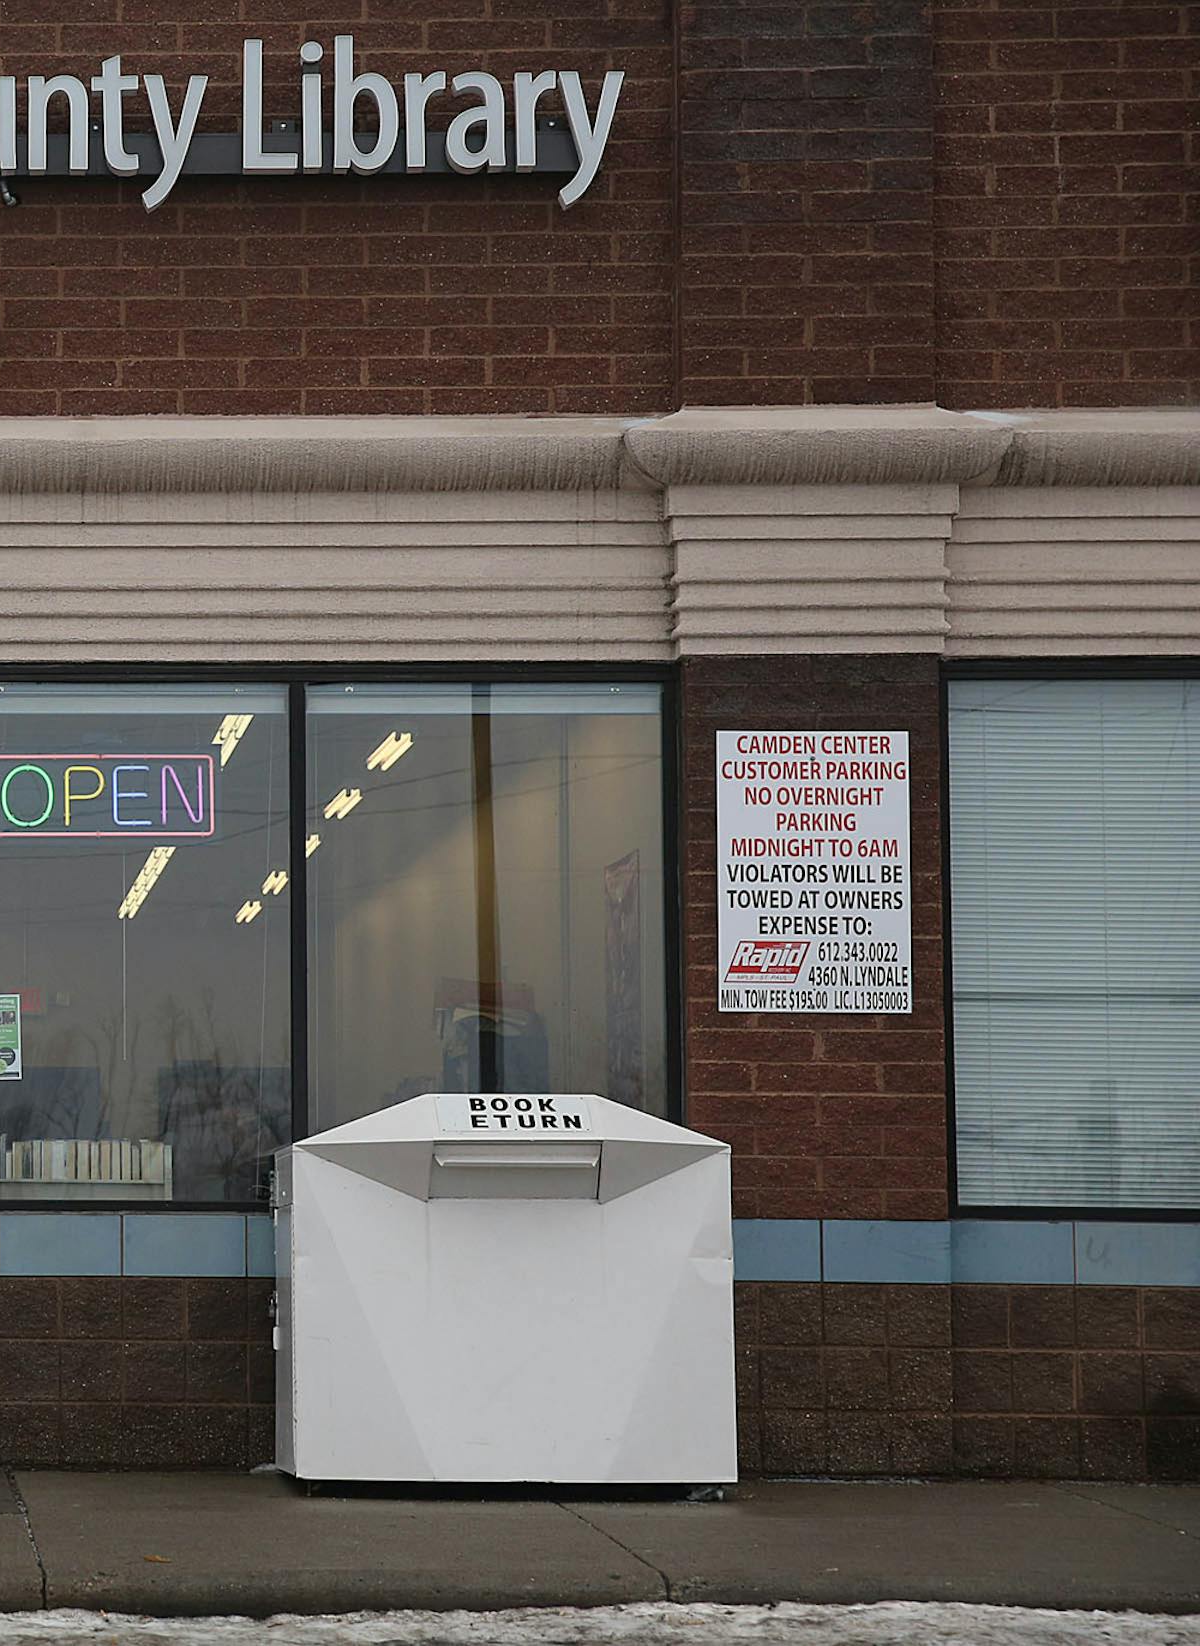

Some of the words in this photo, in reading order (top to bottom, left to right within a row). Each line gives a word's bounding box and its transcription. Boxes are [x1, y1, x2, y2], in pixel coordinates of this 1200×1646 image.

[242, 35, 625, 211] Library
[736, 735, 816, 754] CAMDEN
[821, 736, 891, 755] CENTER
[722, 761, 821, 780] CUSTOMER
[826, 761, 906, 781] PARKING
[0, 764, 204, 827] OPEN
[744, 787, 772, 805] NO
[777, 787, 884, 806] OVERNIGHT
[776, 813, 856, 832] PARKING
[731, 838, 825, 857] MIDNIGHT
[829, 839, 853, 857] TO
[857, 839, 898, 857] 6AM
[727, 864, 828, 883] VIOLATORS
[832, 865, 876, 884] WILL
[881, 865, 903, 884] BE
[727, 890, 793, 909] TOWED
[798, 890, 820, 909] AT
[825, 891, 903, 910] OWNERS
[759, 916, 838, 935] EXPENSE
[842, 917, 872, 935] TO:
[733, 942, 808, 973] Rapid
[818, 941, 898, 962] 612.343.0022
[808, 966, 837, 986] 4360
[840, 966, 852, 987] N.
[855, 966, 908, 987] LYNDALE
[721, 989, 743, 1009] MIN.
[744, 989, 768, 1009] TOW
[770, 990, 787, 1009] FEE
[789, 989, 828, 1010] $195.00
[834, 991, 852, 1010] LIC.
[855, 991, 908, 1010] L13050003
[469, 1098, 557, 1112] BOOK
[470, 1115, 582, 1129] ETURN
